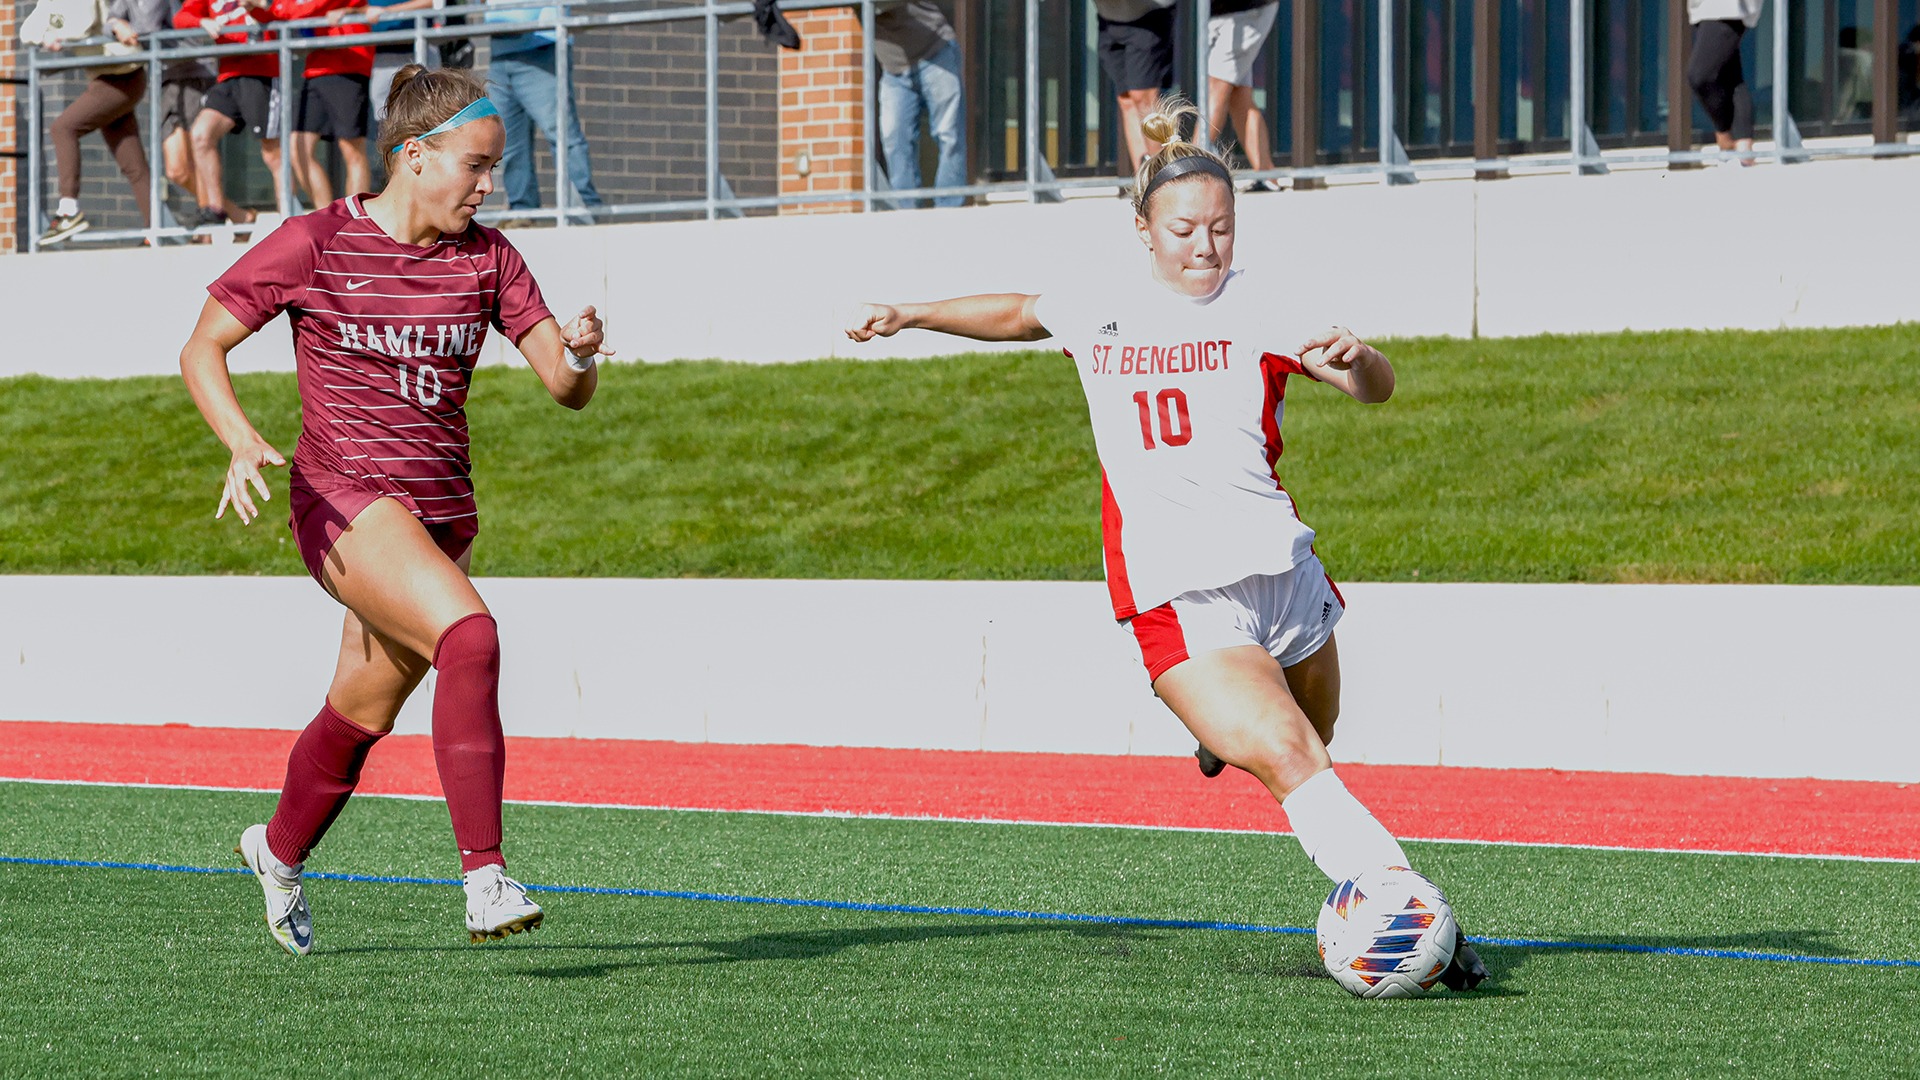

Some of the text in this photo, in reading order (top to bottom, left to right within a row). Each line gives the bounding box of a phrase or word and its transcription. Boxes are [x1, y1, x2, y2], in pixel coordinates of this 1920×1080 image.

[337, 321, 481, 358] HAMLINE
[1092, 340, 1233, 375] ST. BENEDICT
[397, 363, 442, 406] 10
[1132, 387, 1193, 451] 10
